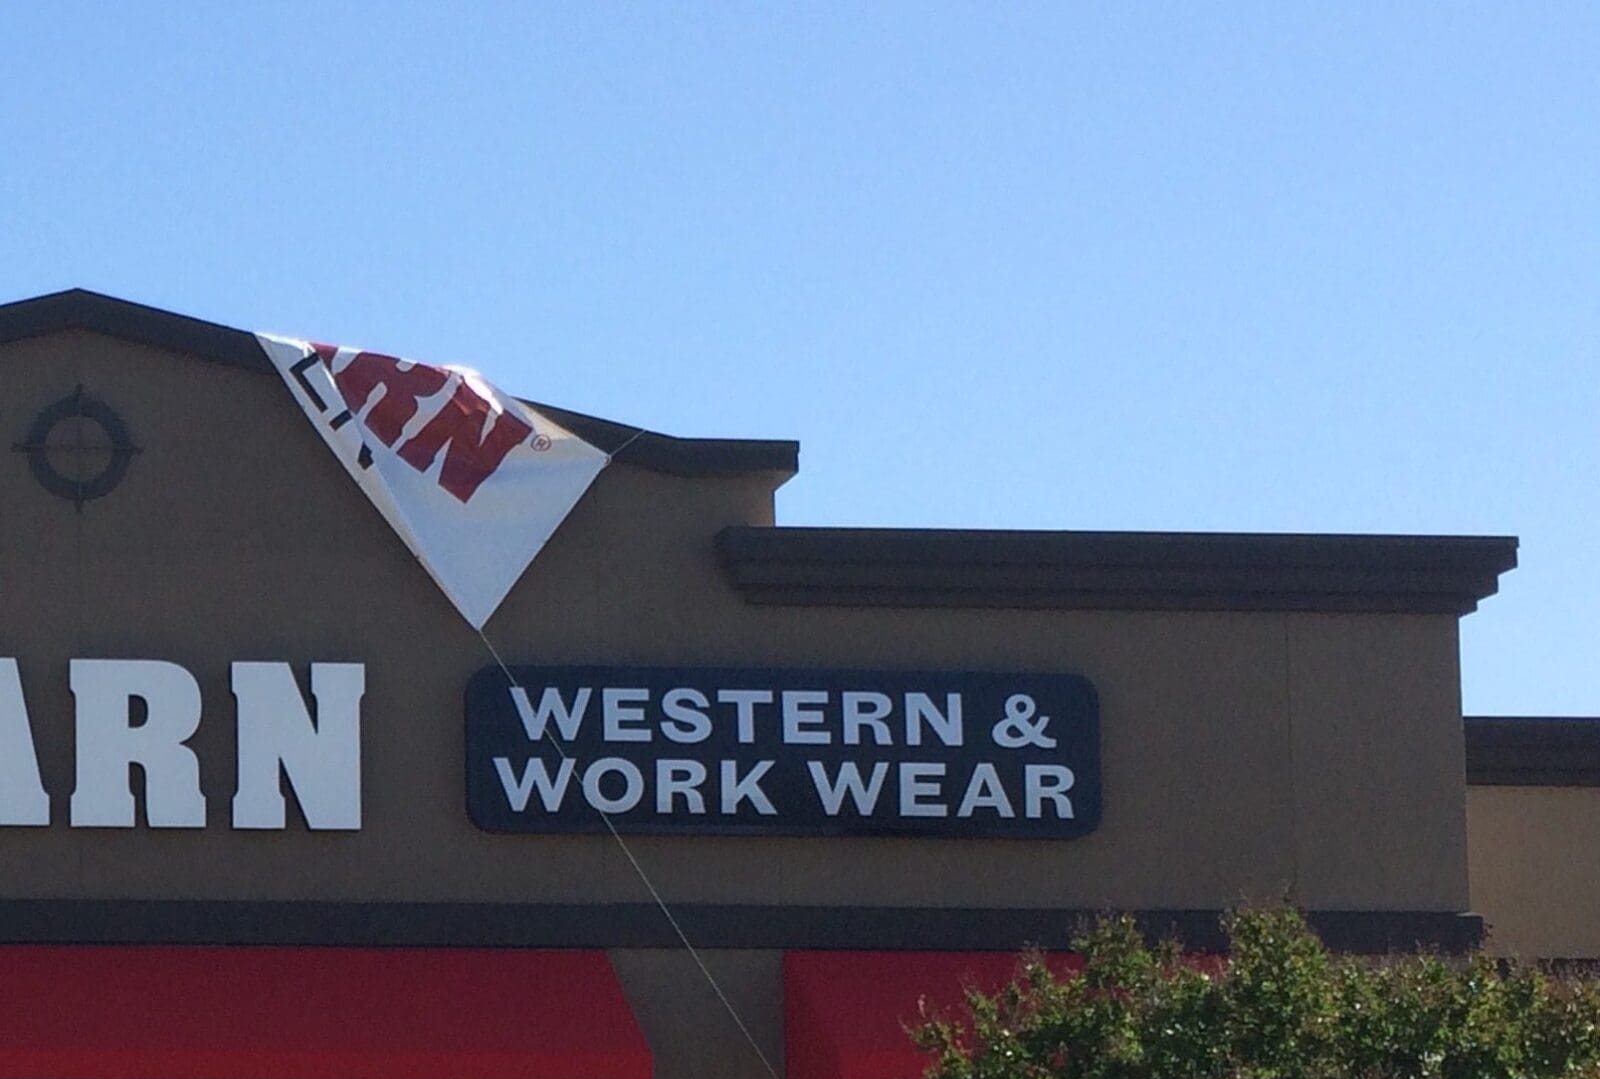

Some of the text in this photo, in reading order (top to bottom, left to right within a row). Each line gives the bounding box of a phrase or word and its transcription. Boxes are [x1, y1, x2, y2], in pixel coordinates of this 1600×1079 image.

[509, 686, 1057, 749] WESTERN &
[493, 756, 1076, 820] WORK WEAR
